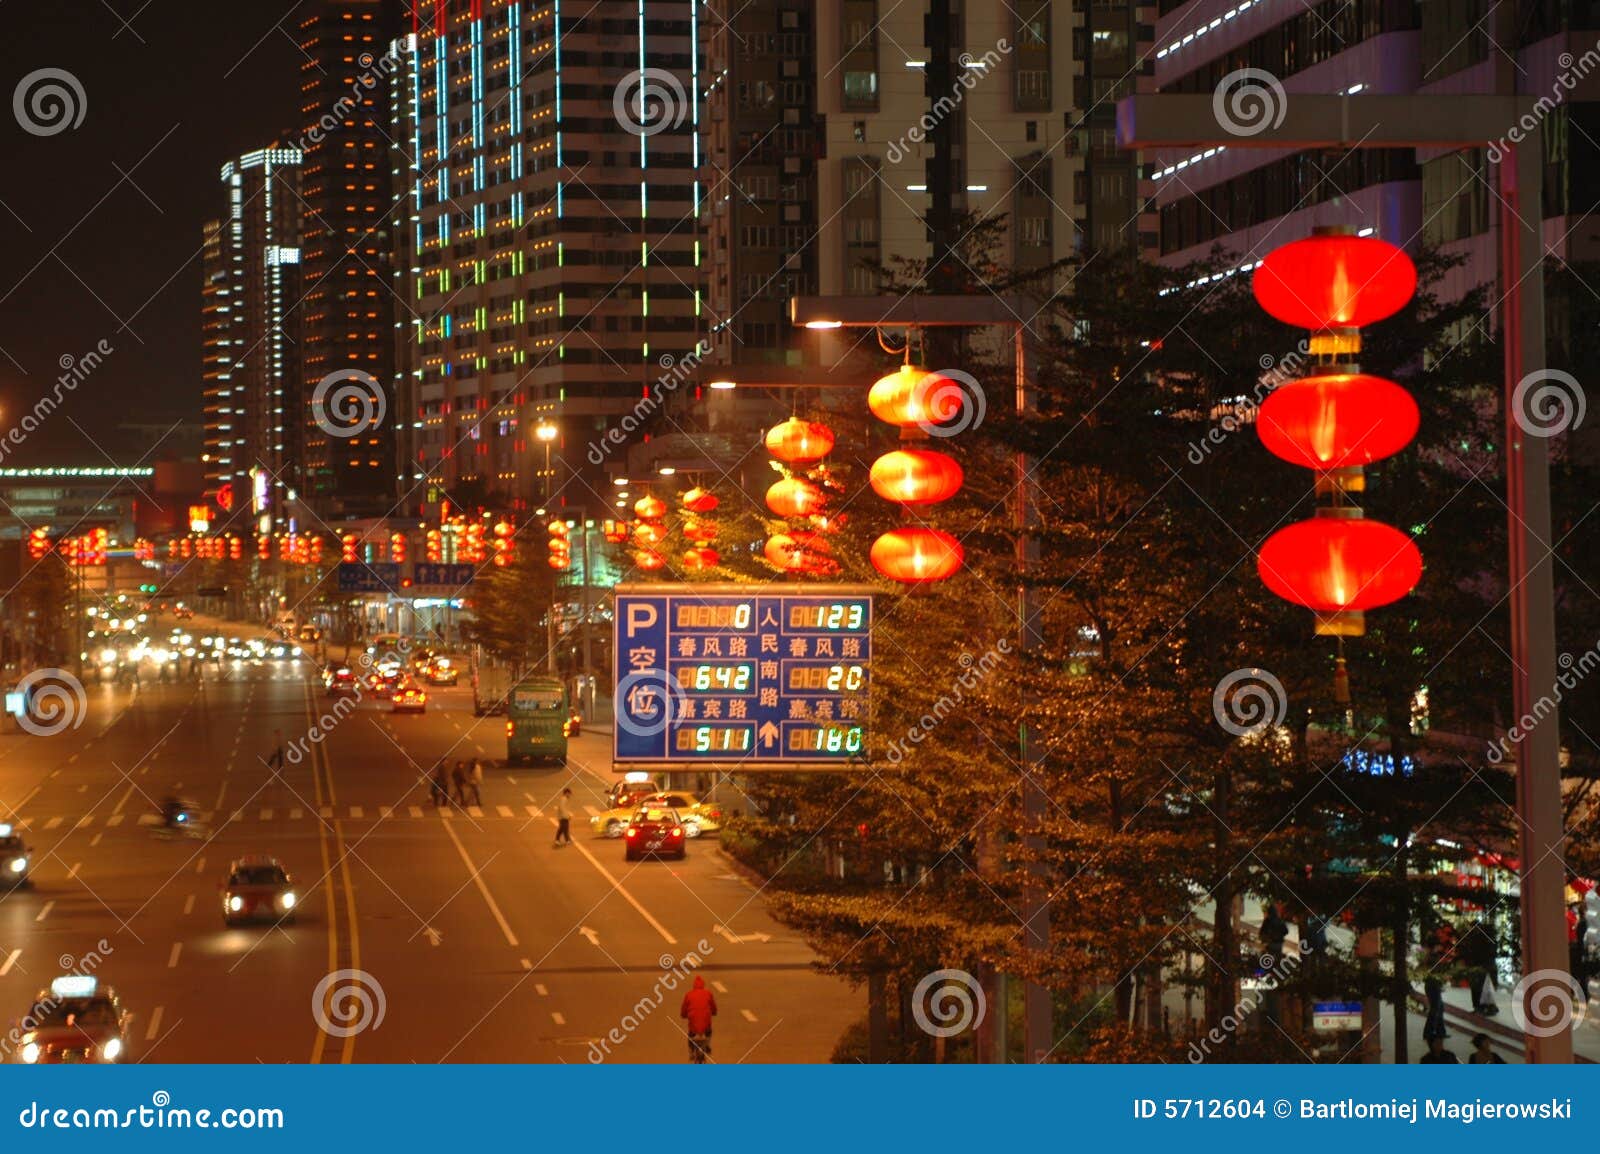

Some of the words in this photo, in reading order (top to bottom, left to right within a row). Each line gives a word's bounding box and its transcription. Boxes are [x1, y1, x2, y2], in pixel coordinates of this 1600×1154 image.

[626, 603, 657, 638] P
[816, 604, 863, 629] 123
[677, 637, 748, 657] 春风路
[759, 607, 779, 708] 人民南路
[788, 637, 861, 658] 春风路
[627, 646, 657, 715] 空位
[695, 665, 750, 690] 642
[695, 727, 750, 752] 511
